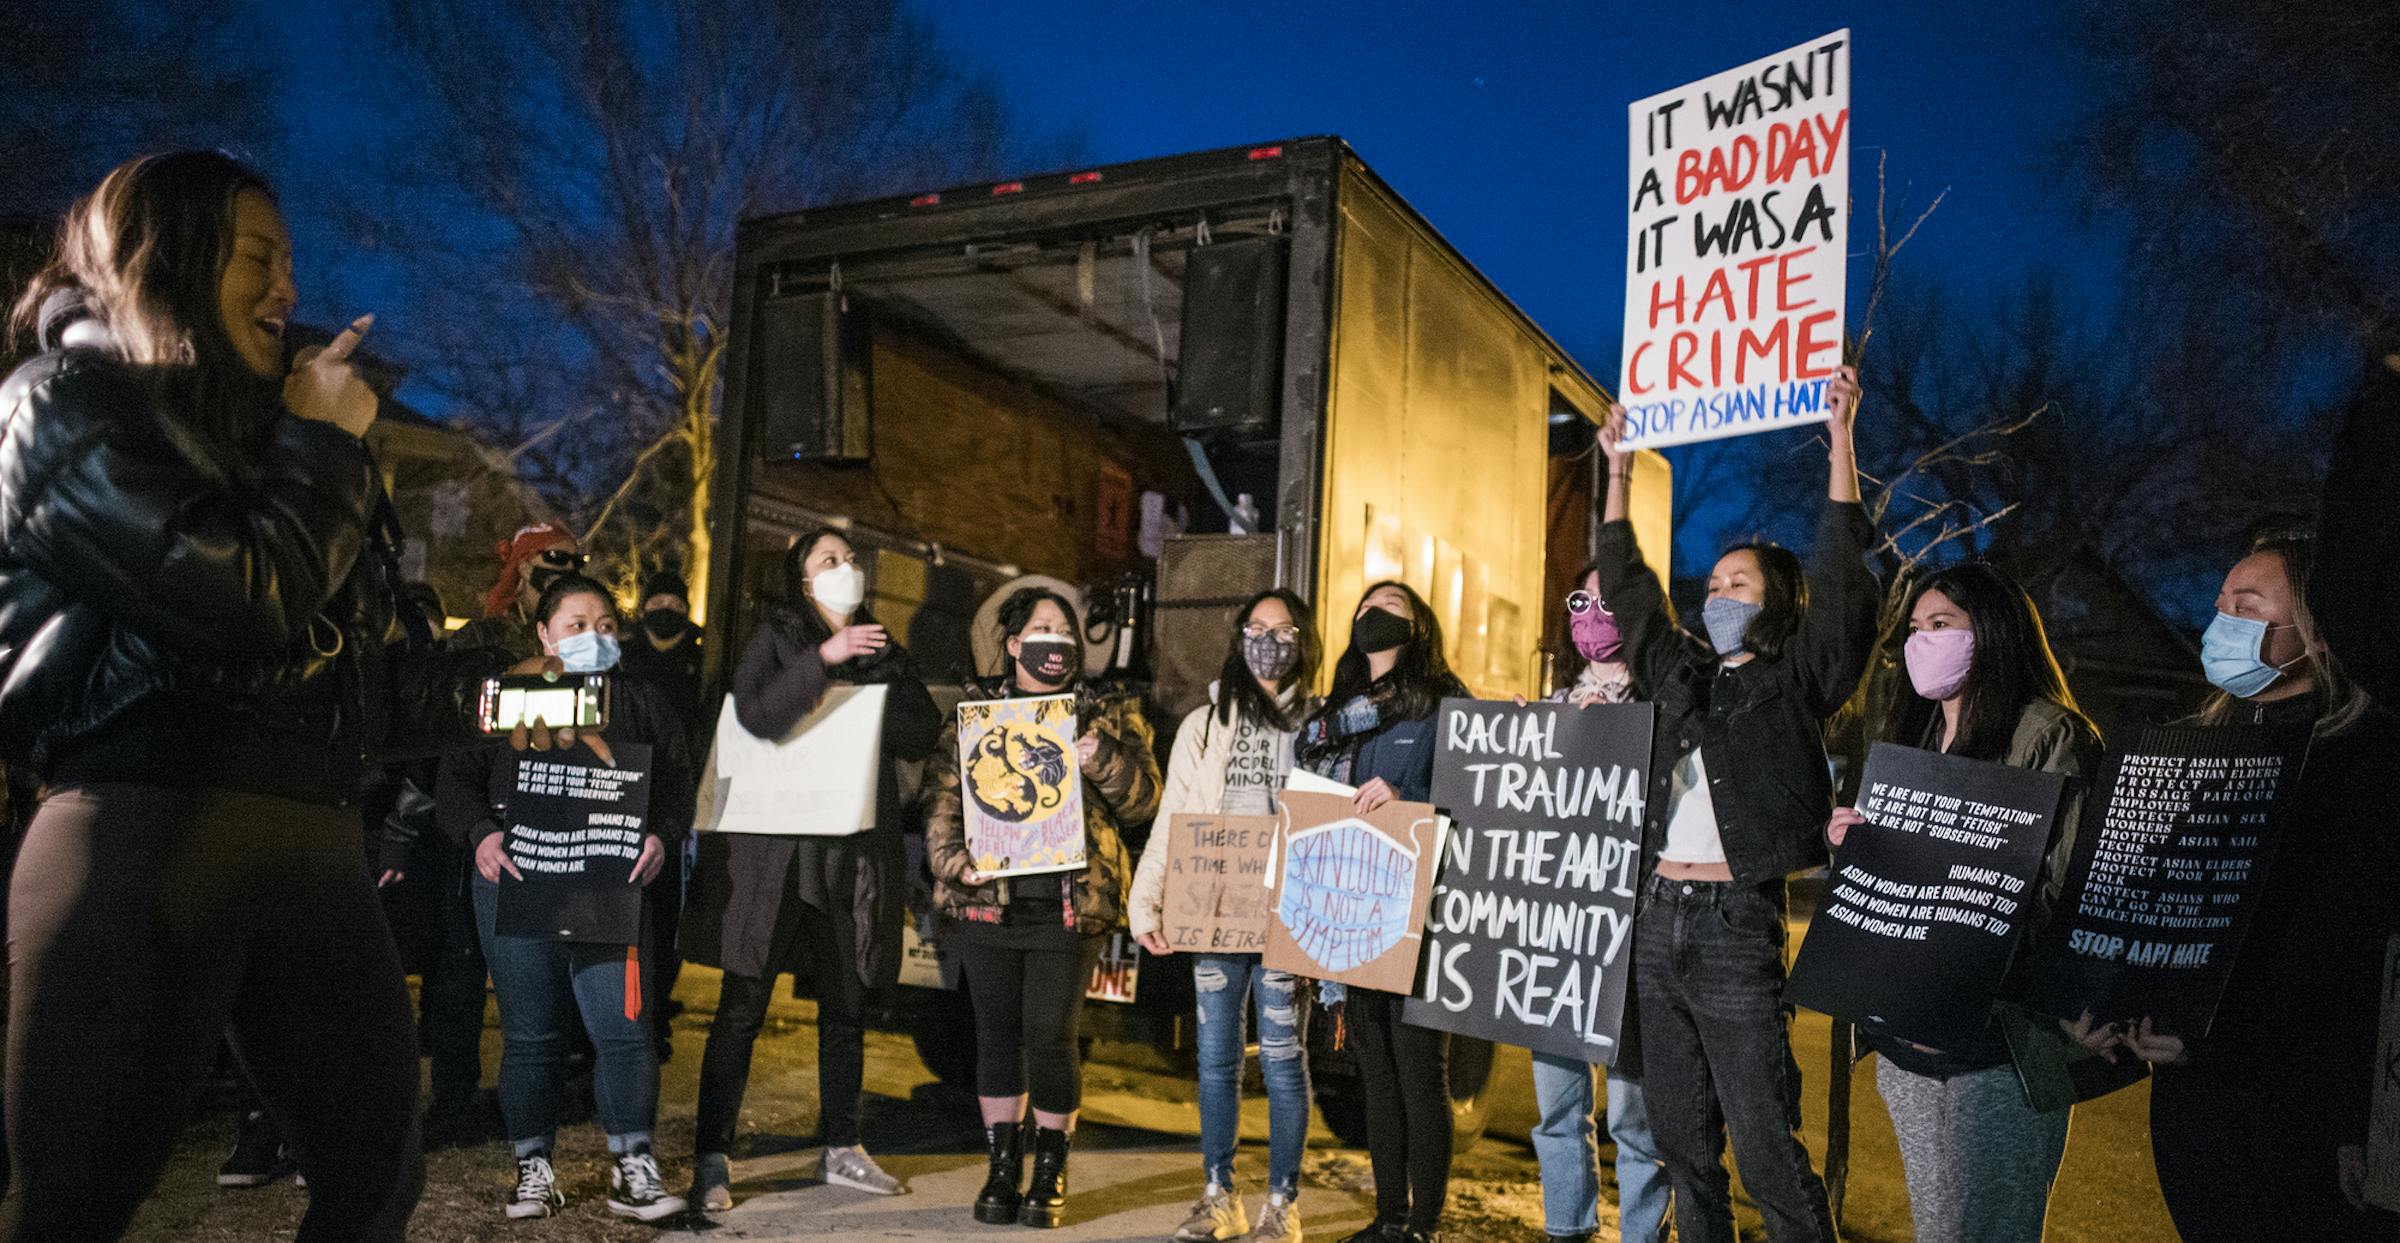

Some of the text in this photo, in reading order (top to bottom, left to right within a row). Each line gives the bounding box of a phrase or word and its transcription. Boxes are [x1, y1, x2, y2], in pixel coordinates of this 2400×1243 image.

[1648, 40, 1843, 156] IT WASNT
[1633, 108, 1848, 212] A BAD DAY
[1637, 183, 1836, 273] IT WAS A
[1649, 245, 1818, 330] HATE
[1629, 309, 1838, 395] CRIME
[1623, 400, 1686, 441] STOP
[1690, 382, 1766, 431] ASIAN
[1048, 653, 1063, 663] NO
[1449, 710, 1563, 761] RACIAL
[518, 760, 532, 771] WE
[532, 762, 549, 772] ARE
[549, 764, 565, 774] NOT
[566, 765, 587, 777] YOUR
[2119, 765, 2281, 779] PROTECT ASIAN ELDERS
[2122, 754, 2283, 769] PROTECT ASIAN WOMEN
[517, 771, 531, 781] WE
[531, 773, 548, 783] ARE
[548, 774, 564, 785] NOT
[566, 776, 586, 787] YOUR
[517, 782, 529, 793] WE
[530, 783, 547, 794] ARE
[547, 785, 563, 796] NOT
[2116, 775, 2278, 790] PROTECT ASIAN
[1463, 762, 1646, 827] TRAUMA
[1871, 782, 1888, 796] WE
[1887, 786, 1910, 800] ARE
[1910, 790, 1933, 805] NOT
[1934, 794, 1962, 811] YOUR
[2110, 797, 2191, 812] EMPLOYEES
[2113, 786, 2275, 801] MASSAGE PARLOUR
[588, 813, 641, 829] HUMANS TOO
[1867, 796, 1884, 811] WE
[1884, 801, 1907, 815] ARE
[1905, 804, 1929, 819] NOT
[1929, 808, 1958, 826] YOUR
[2107, 808, 2267, 824] PROTECT ASIAN SEX
[1865, 811, 1881, 825] WE
[1879, 815, 1903, 830] ARE
[1901, 819, 1925, 834] NOT
[2105, 818, 2172, 834] WORKERS
[511, 824, 641, 844] ASIAN WOMEN ARE HUMANS TOO
[1187, 822, 1250, 848] THERE
[2100, 828, 2259, 847] PROTECT ASIAN NAIL
[509, 839, 639, 860] ASIAN WOMEN ARE HUMANS TOO
[2098, 839, 2145, 854] TECHS
[536, 860, 568, 873] WOMEN
[568, 860, 585, 873] ARE
[1172, 857, 1183, 874] A
[1190, 856, 1227, 874] TIME
[1289, 826, 1413, 898] SKIN COLOR
[1483, 829, 1561, 886] THE
[1555, 832, 1640, 898] AAPI
[2091, 861, 2248, 881] PROTECT POOR ASIAN
[2094, 850, 2252, 870] PROTECT ASIAN ELDERS
[1948, 864, 2026, 894] HUMANS TOO
[2088, 871, 2125, 886] FOLK
[1839, 864, 2018, 916] ASIAN WOMEN ARE HUMANS TOO
[2084, 882, 2240, 904] PROTECT ASIANS WHO
[1300, 883, 1383, 924] IS NOT A
[1832, 883, 2011, 938] ASIAN WOMEN ARE HUMANS TOO
[2129, 900, 2149, 912] GO
[2155, 903, 2172, 913] TO
[2177, 905, 2200, 916] THE
[1426, 884, 1631, 967] COMMUNITY
[1826, 903, 1930, 941] ASIAN WOMEN ARE
[2078, 904, 2233, 928] POLICE FOR PROTECTION
[1172, 926, 1203, 946] IS
[1289, 907, 1384, 971] SYMPTOM
[2069, 928, 2214, 966] STOP AAPI HATE
[1426, 939, 1614, 1047] IS REAL
